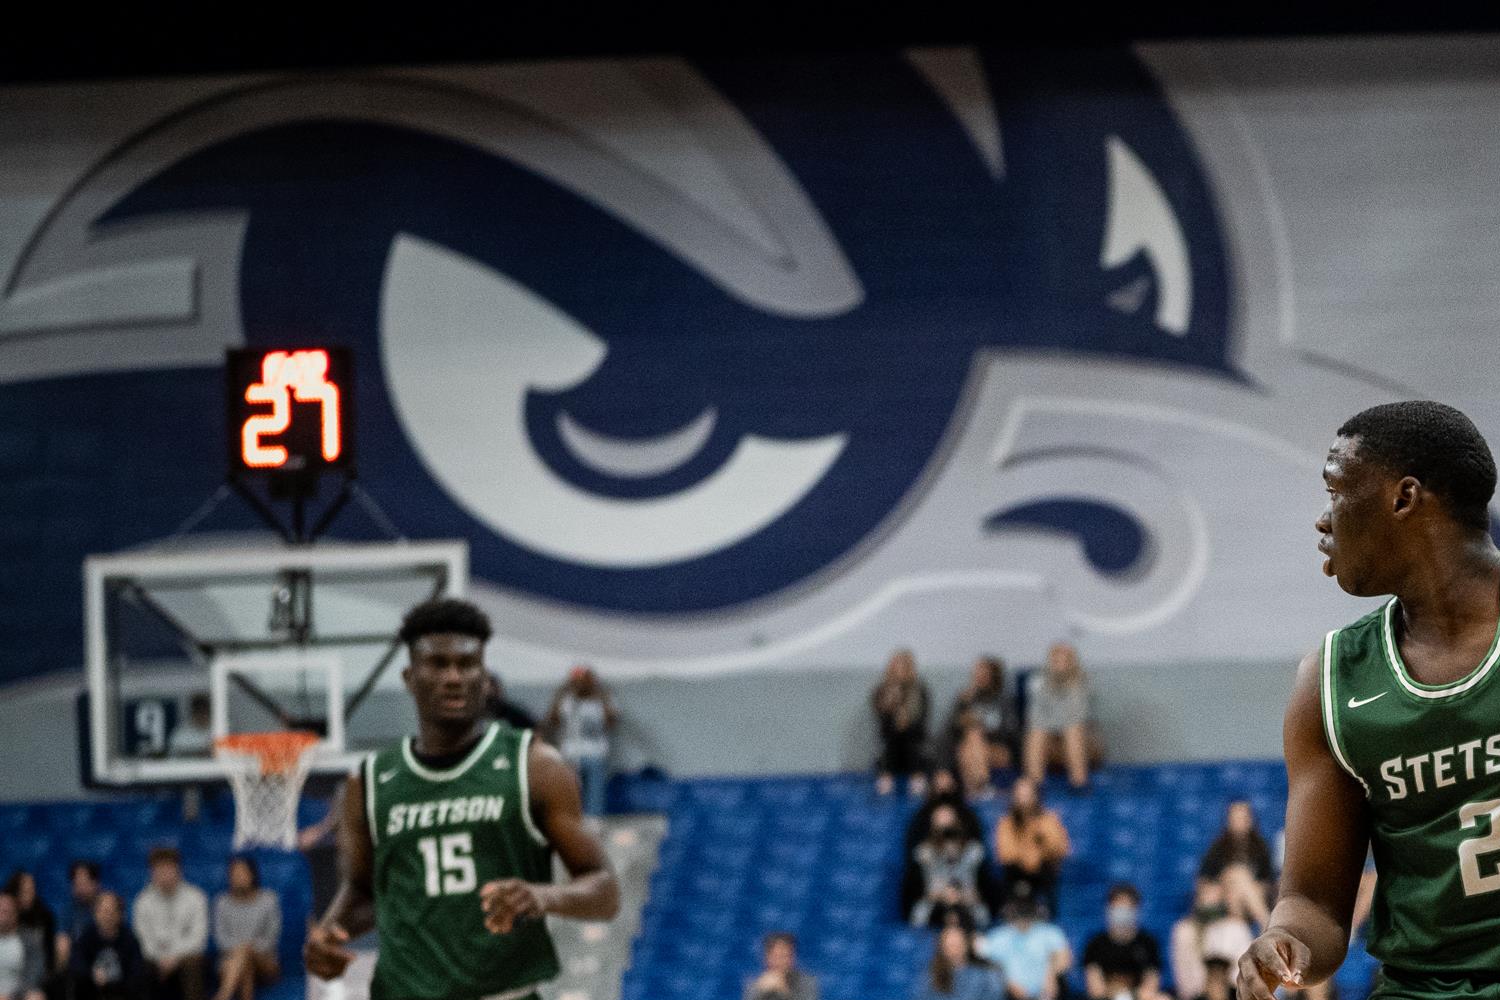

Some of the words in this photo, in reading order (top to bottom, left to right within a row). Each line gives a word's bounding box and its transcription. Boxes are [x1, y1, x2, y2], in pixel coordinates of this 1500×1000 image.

[241, 381, 342, 468] 27
[135, 701, 166, 751] 9
[386, 795, 505, 836] STETSON
[417, 832, 477, 897] 15
